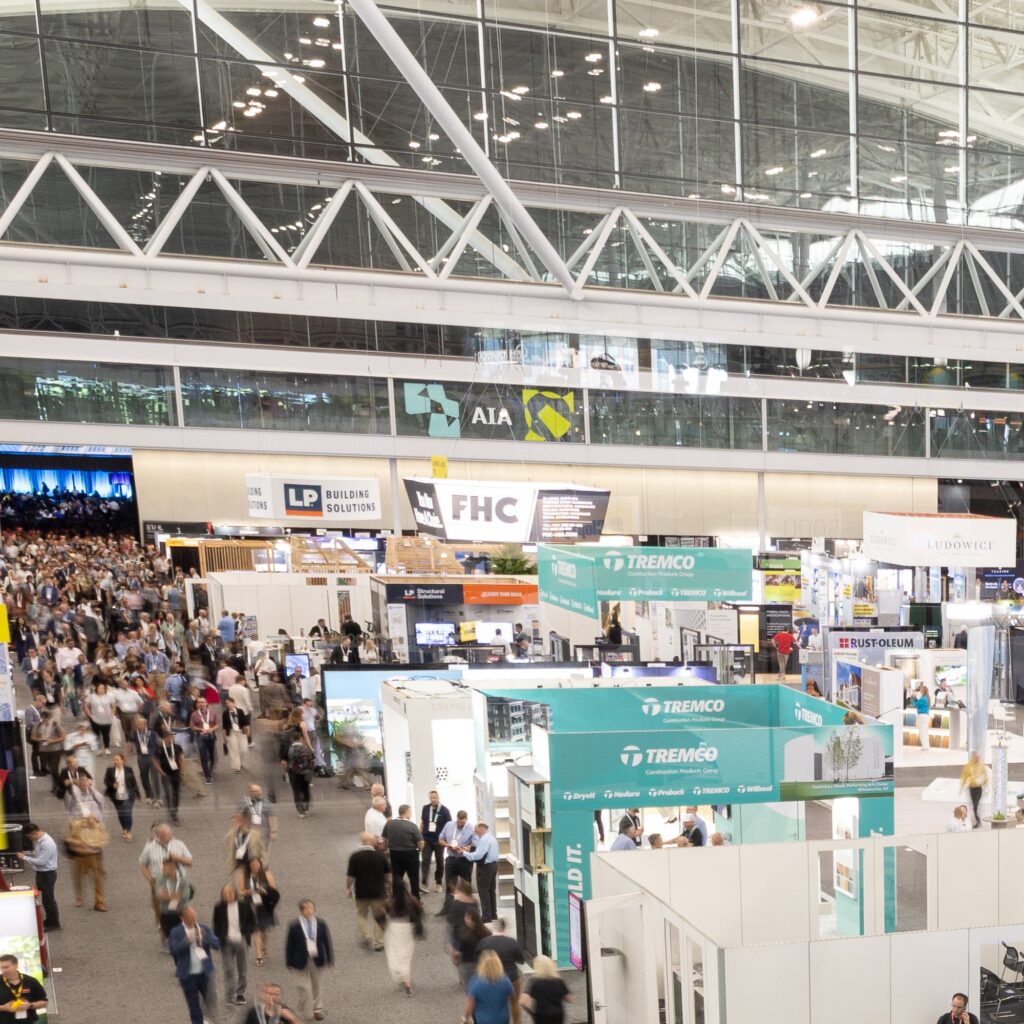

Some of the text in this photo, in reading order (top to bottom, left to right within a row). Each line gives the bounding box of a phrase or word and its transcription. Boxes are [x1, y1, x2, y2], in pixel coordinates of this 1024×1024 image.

[472, 406, 513, 426] AIA
[288, 488, 318, 507] LP
[326, 490, 370, 499] BUILDING
[327, 502, 376, 513] SOLUTIONS
[452, 494, 519, 524] FHC
[927, 540, 994, 550] LUDOWICI
[627, 554, 696, 570] TREMCO
[663, 699, 726, 713] TREMCO
[801, 708, 823, 727] TREMCO
[646, 746, 719, 764] TREMCO
[573, 792, 596, 800] Dryvit
